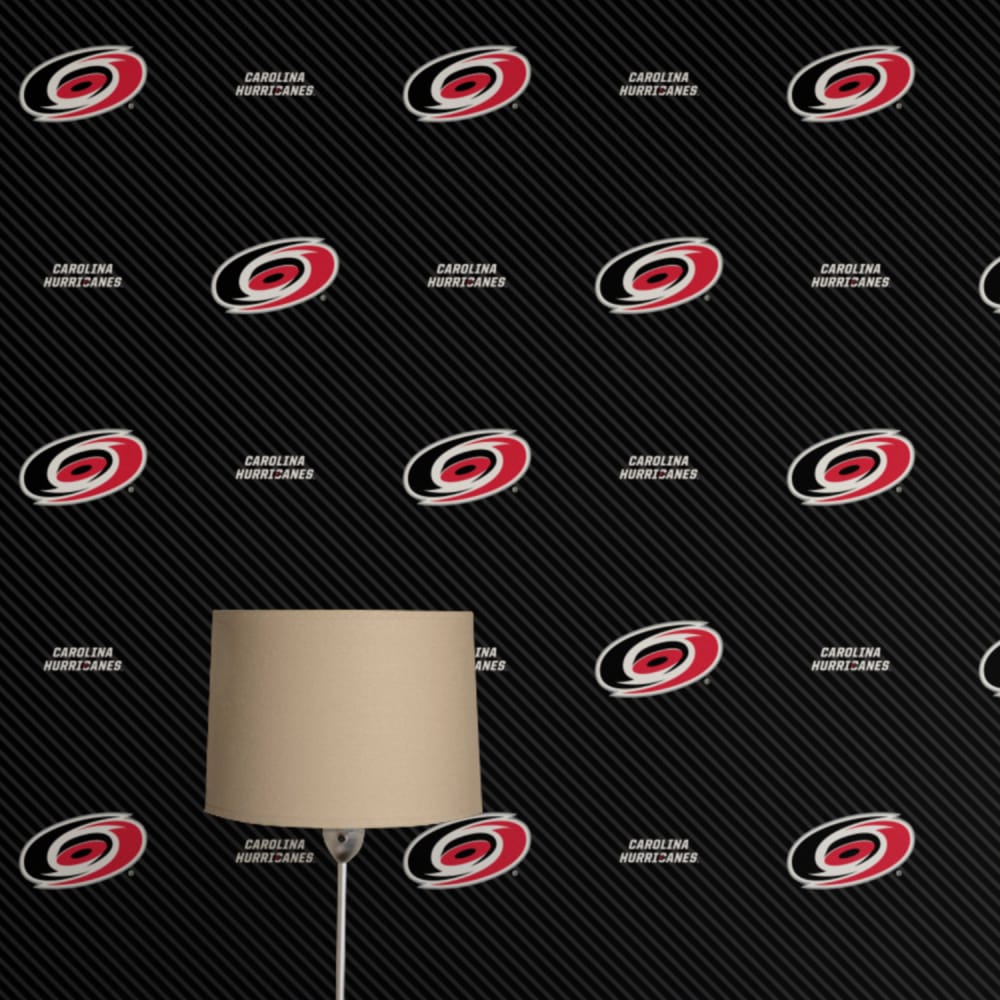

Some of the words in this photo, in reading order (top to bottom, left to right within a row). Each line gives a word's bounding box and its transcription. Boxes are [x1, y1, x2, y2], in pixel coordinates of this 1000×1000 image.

[244, 71, 305, 83] CAROLINA
[628, 71, 689, 83] CAROLINA
[235, 84, 315, 97] HURRICANES
[619, 84, 699, 97] HURRICANES
[52, 263, 113, 275] CAROLINA
[436, 263, 497, 275] CAROLINA
[820, 263, 881, 275] CAROLINA
[43, 276, 123, 289] HURRICANES
[427, 276, 507, 289] HURRICANES
[811, 276, 891, 289] HURRICANES
[244, 455, 305, 467] CAROLINA
[628, 455, 689, 467] CAROLINA
[235, 468, 315, 481] HURRICANES
[619, 468, 699, 481] HURRICANES
[52, 646, 113, 658] CAROLINA
[820, 646, 881, 658] CAROLINA
[43, 659, 123, 672] HURRICANES
[811, 659, 891, 672] HURRICANES
[244, 838, 305, 850] CAROLINA
[628, 838, 689, 850] CAROLINA
[235, 851, 315, 864] HURRICANES
[619, 851, 699, 864] HURRICANES
